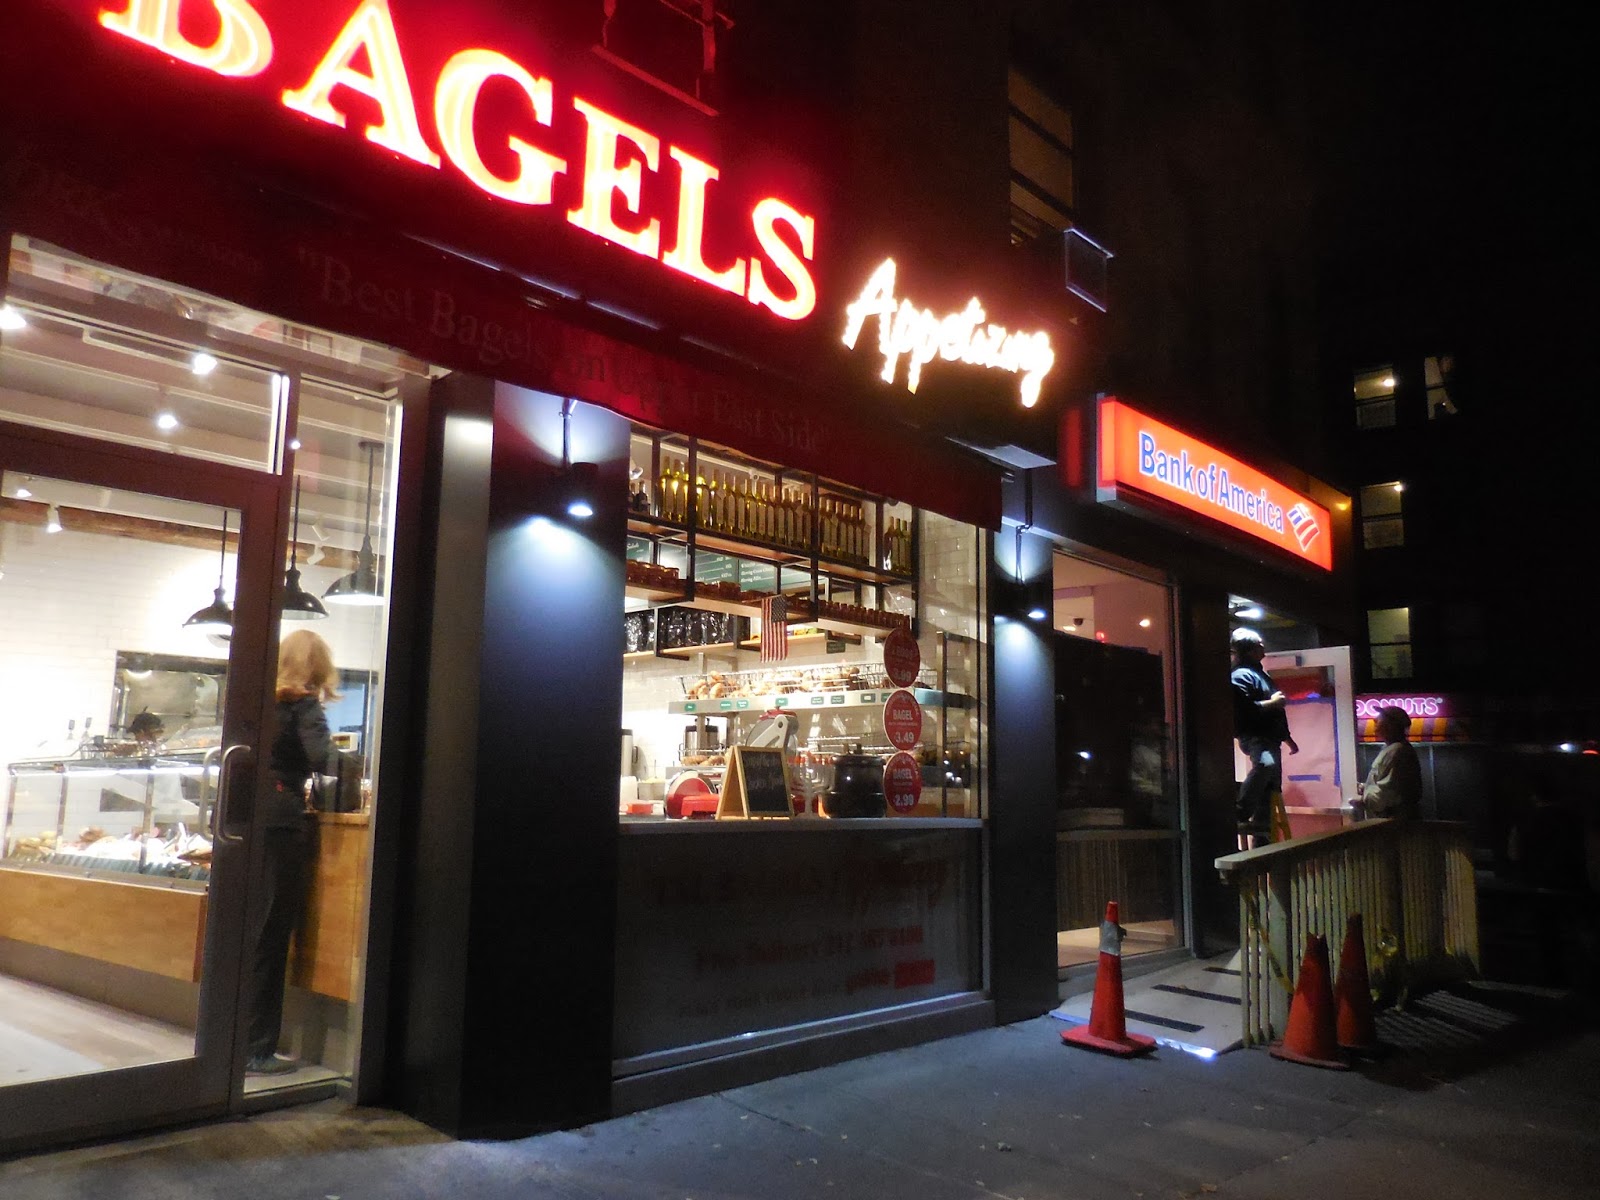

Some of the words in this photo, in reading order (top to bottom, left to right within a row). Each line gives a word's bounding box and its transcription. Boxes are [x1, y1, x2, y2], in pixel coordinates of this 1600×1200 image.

[842, 256, 1055, 408] Appetizing
[1138, 430, 1194, 496] Bank
[1195, 463, 1217, 503] of
[1216, 467, 1285, 535] America
[892, 709, 914, 721] BAGEL
[892, 768, 913, 780] BAGEL
